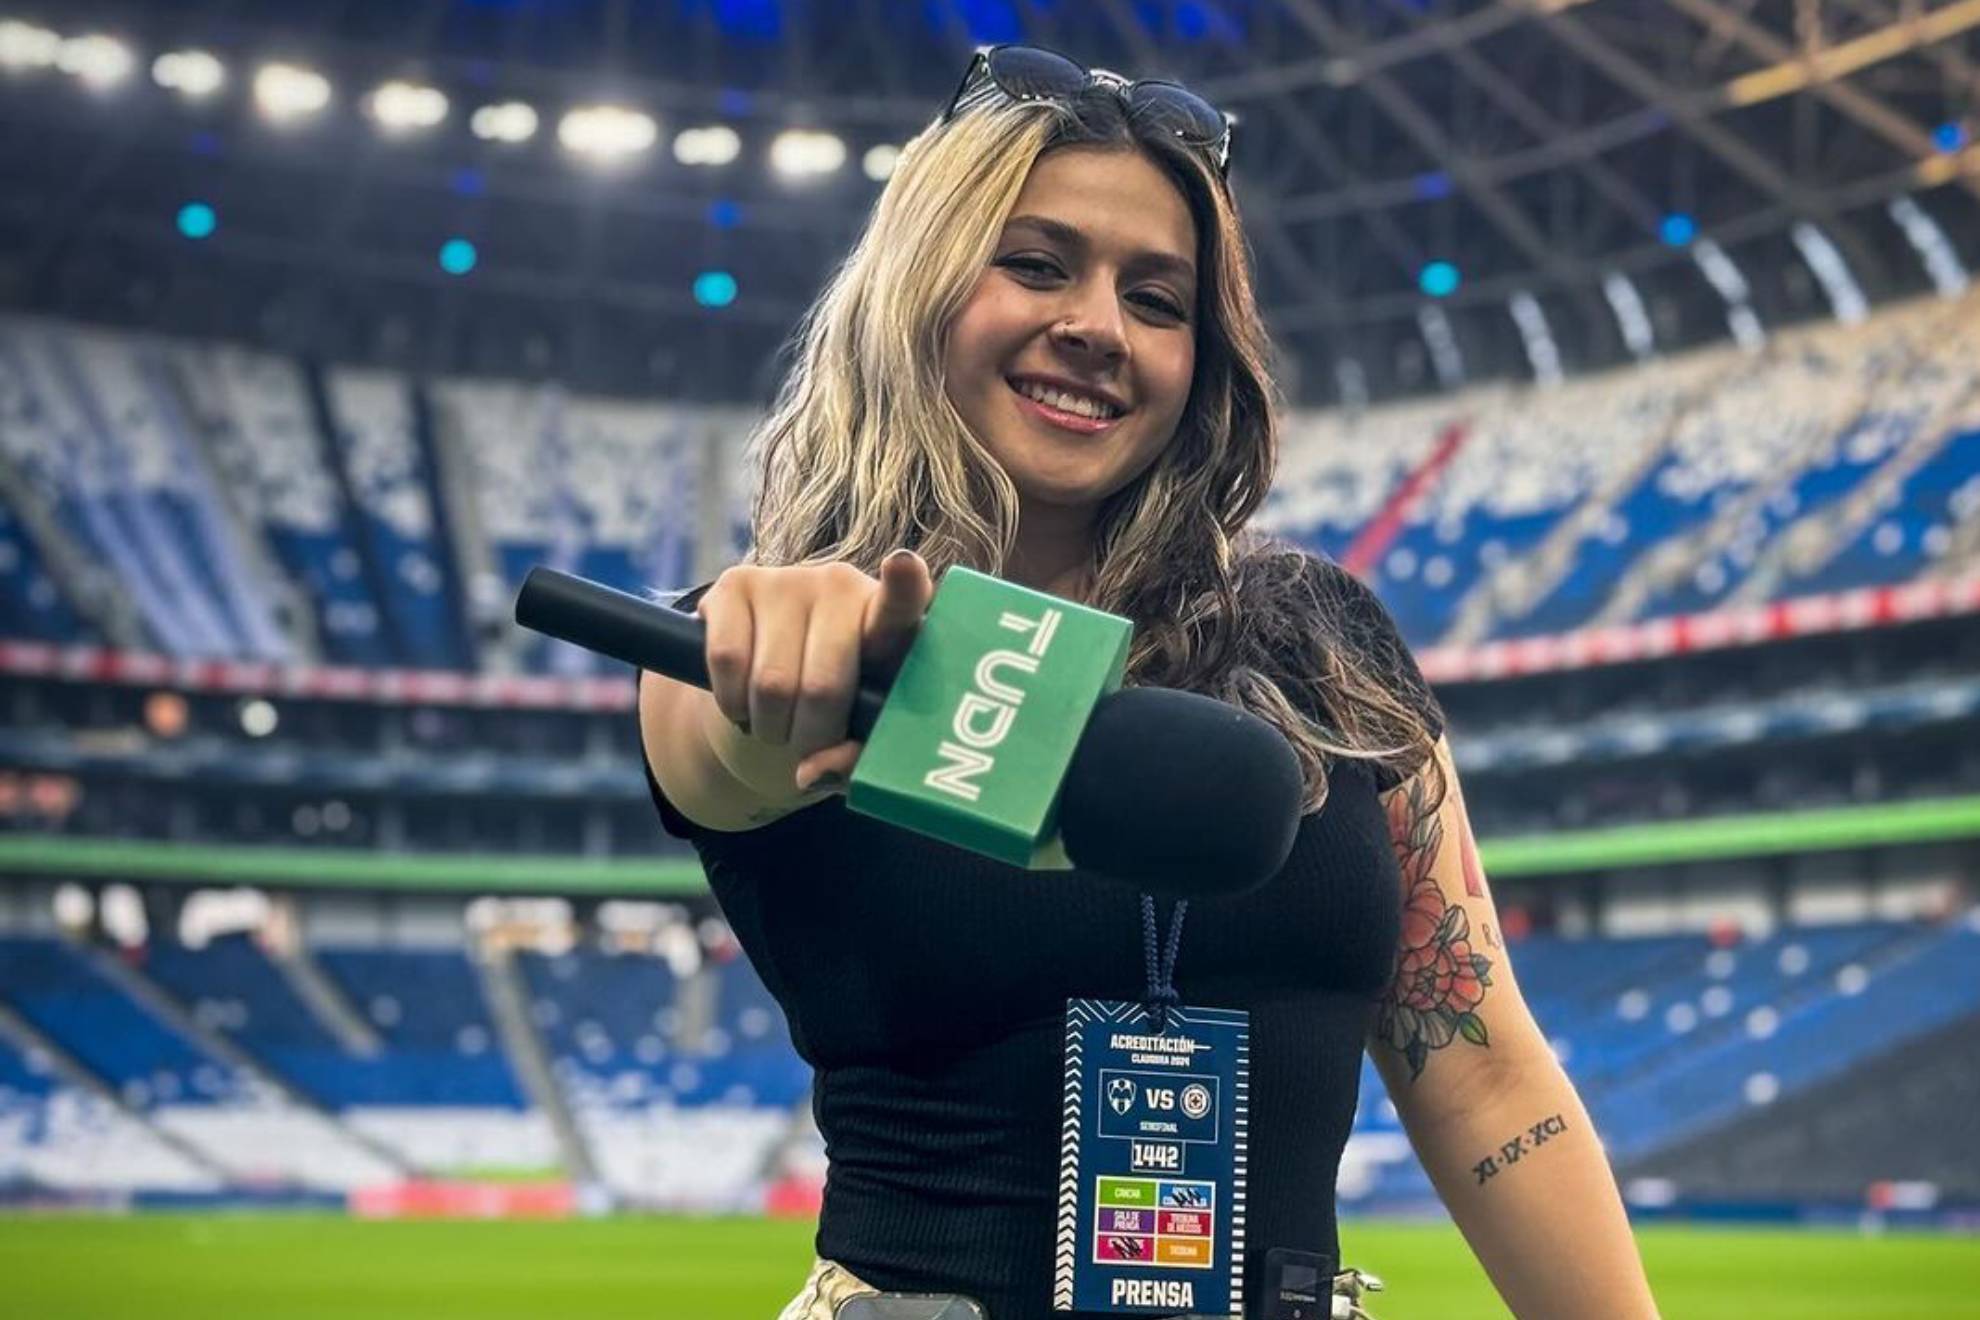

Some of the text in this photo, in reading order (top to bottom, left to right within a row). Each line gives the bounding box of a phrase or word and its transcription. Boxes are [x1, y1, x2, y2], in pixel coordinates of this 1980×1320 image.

[924, 608, 1063, 802] TUDN
[1111, 1034, 1195, 1053] ACREDITACIÓN
[1146, 1088, 1175, 1111] VS
[1133, 1144, 1179, 1168] 1442
[1111, 1278, 1194, 1308] PRENSA
